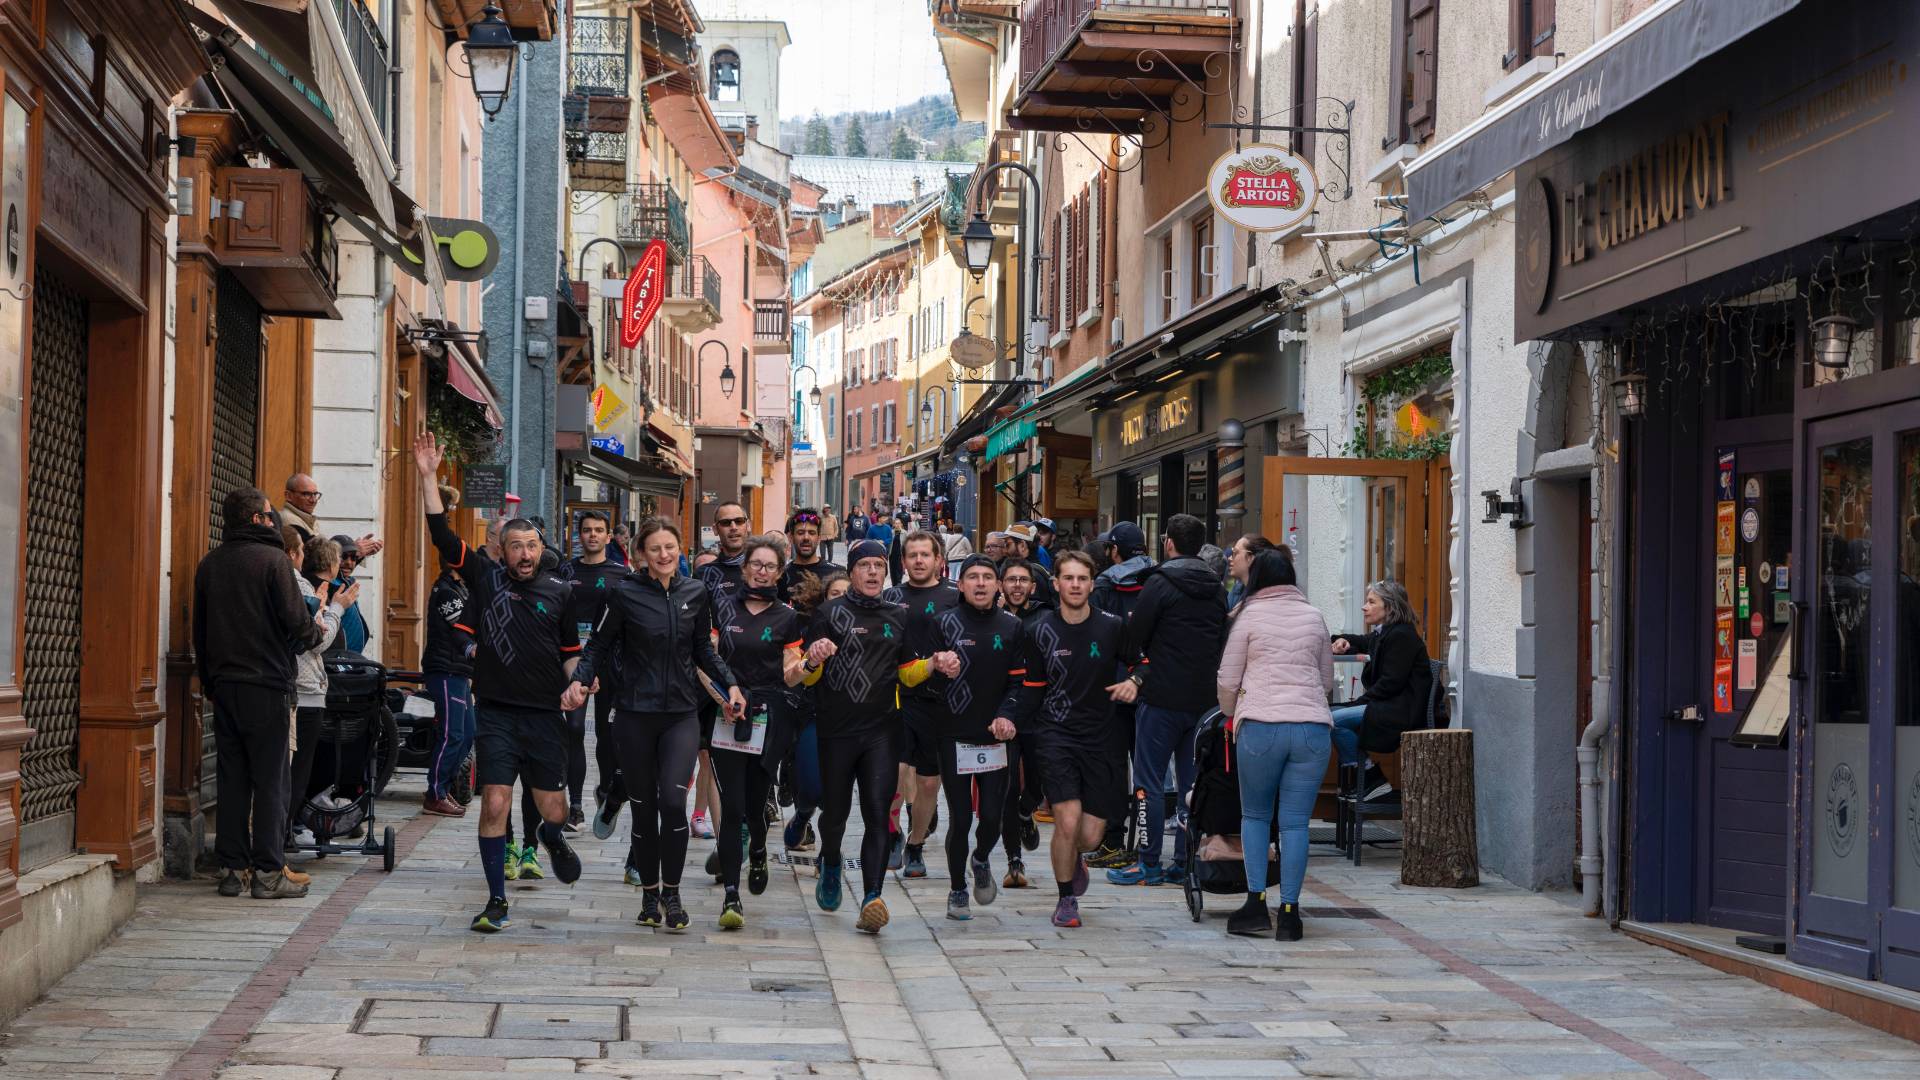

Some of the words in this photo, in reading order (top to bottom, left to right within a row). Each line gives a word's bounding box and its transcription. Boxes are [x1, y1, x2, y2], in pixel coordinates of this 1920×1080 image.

[1237, 177, 1290, 189] STELLA
[1562, 182, 1585, 267] LE
[1596, 111, 1729, 250] CHALUPOT
[1236, 190, 1290, 202] ARTOIS
[633, 267, 655, 320] TABAC
[976, 752, 987, 764] 6
[1139, 810, 1147, 825] DO
[1140, 826, 1149, 846] JUST
